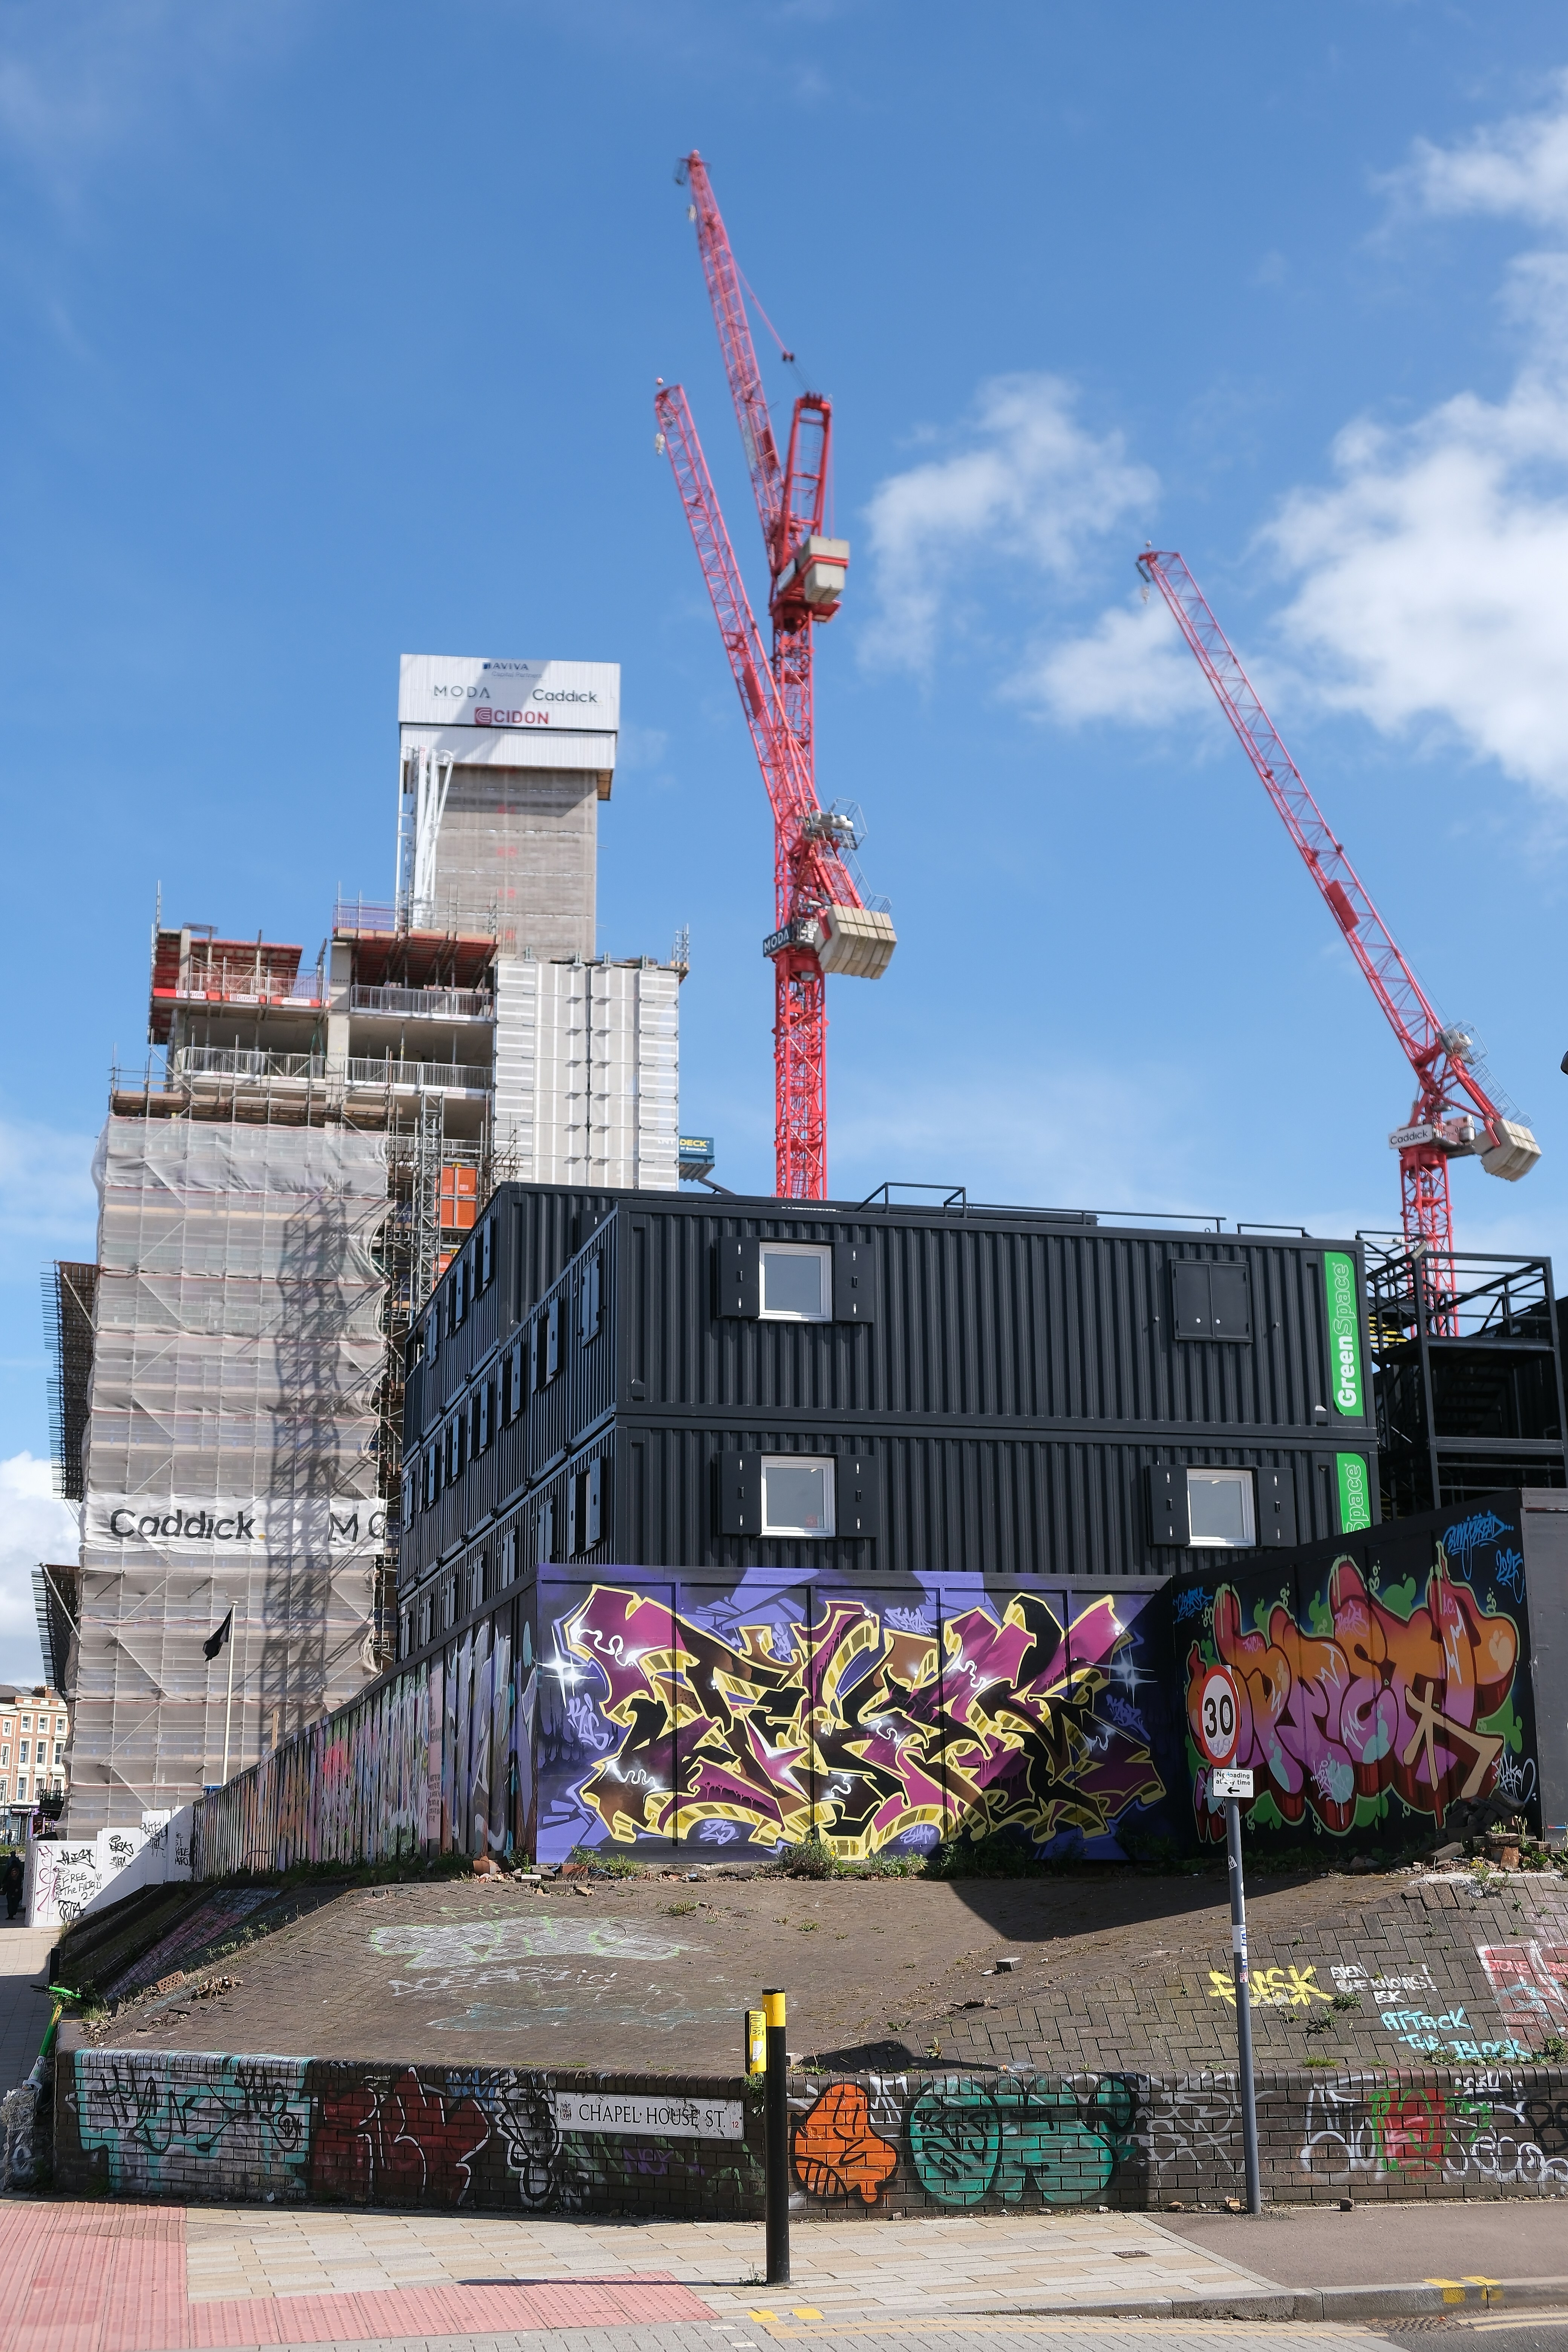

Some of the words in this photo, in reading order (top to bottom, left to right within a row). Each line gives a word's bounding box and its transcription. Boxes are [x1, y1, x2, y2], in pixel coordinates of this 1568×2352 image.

[434, 685, 490, 698] MODA
[533, 689, 597, 703] Caddick
[495, 709, 549, 724] CIDON
[764, 928, 789, 953] MODA
[680, 1139, 707, 1147] DECK
[1390, 1129, 1428, 1144] Caddick
[1333, 1263, 1357, 1407] GreenSpace
[1204, 1695, 1233, 1738] 30
[63, 1873, 87, 1887] FREE
[60, 1885, 77, 1896] The
[1330, 1962, 1369, 1979] EVEN
[1336, 1979, 1369, 1992] SHE
[1381, 2006, 1473, 2031] ATTACK
[579, 2104, 640, 2124] CHAPEL
[646, 2107, 699, 2127] HOUSE
[706, 2110, 726, 2128] ST.
